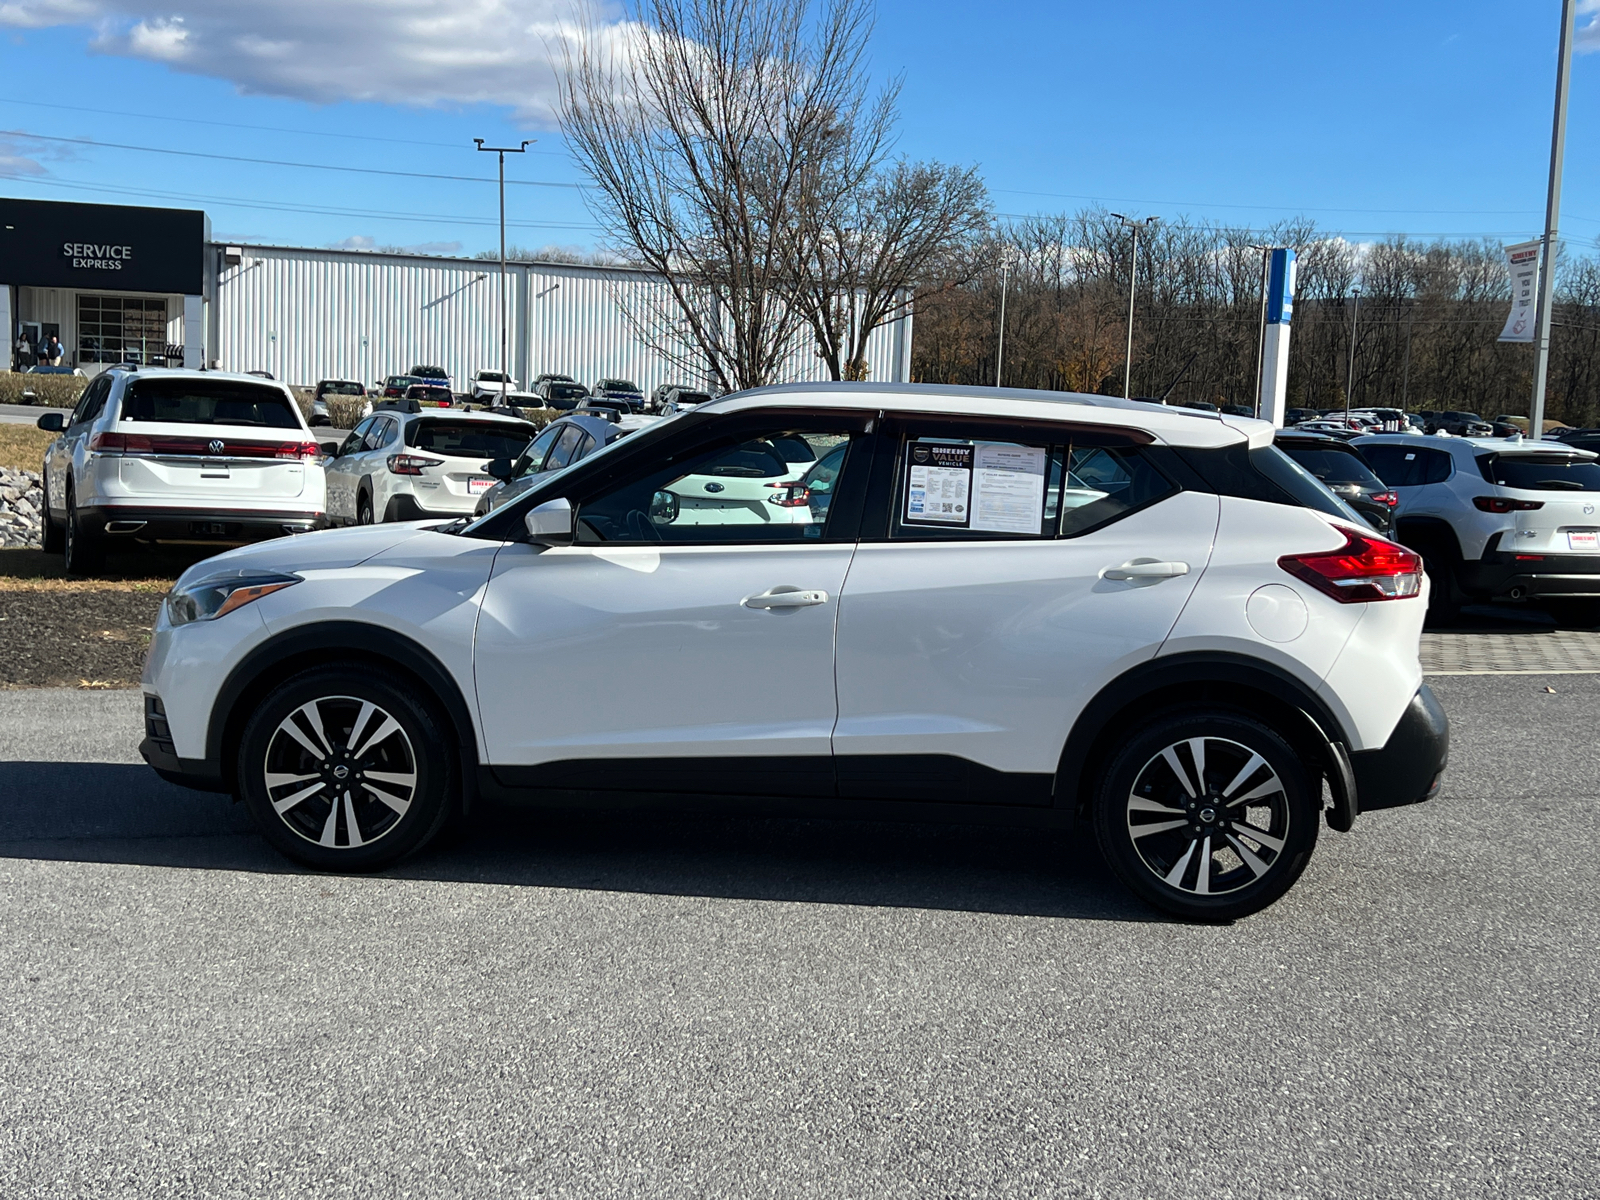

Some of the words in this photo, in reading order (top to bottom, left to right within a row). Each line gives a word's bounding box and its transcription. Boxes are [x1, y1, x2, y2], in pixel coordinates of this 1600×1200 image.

[63, 242, 132, 259] SERVICE
[72, 258, 122, 270] EXPRESS
[932, 447, 970, 455] SHEEHY
[932, 454, 970, 462] VALUE
